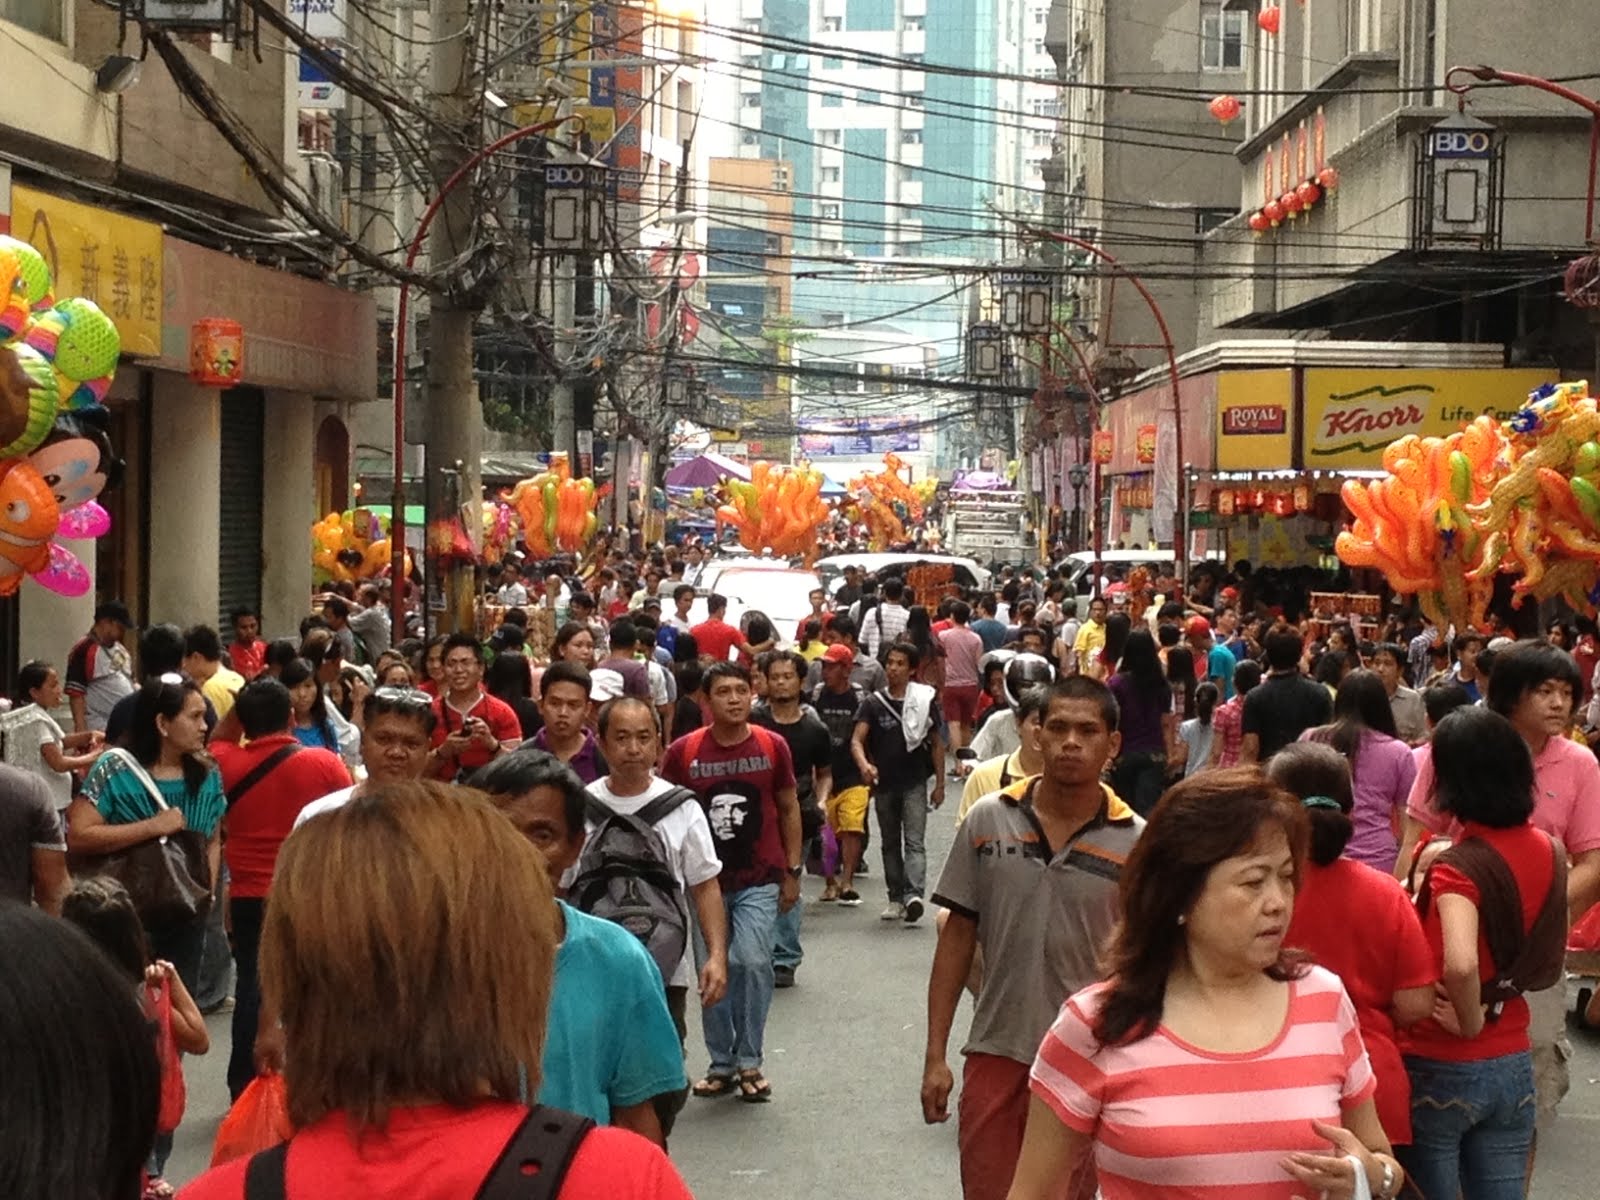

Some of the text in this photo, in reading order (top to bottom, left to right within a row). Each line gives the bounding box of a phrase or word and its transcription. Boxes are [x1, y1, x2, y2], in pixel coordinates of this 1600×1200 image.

[1435, 132, 1489, 153] BDO
[546, 167, 584, 184] BDO
[1230, 407, 1278, 428] ROYAL
[1323, 404, 1425, 438] Knorr
[1441, 406, 1474, 421] Life
[689, 756, 773, 779] GUEVARA
